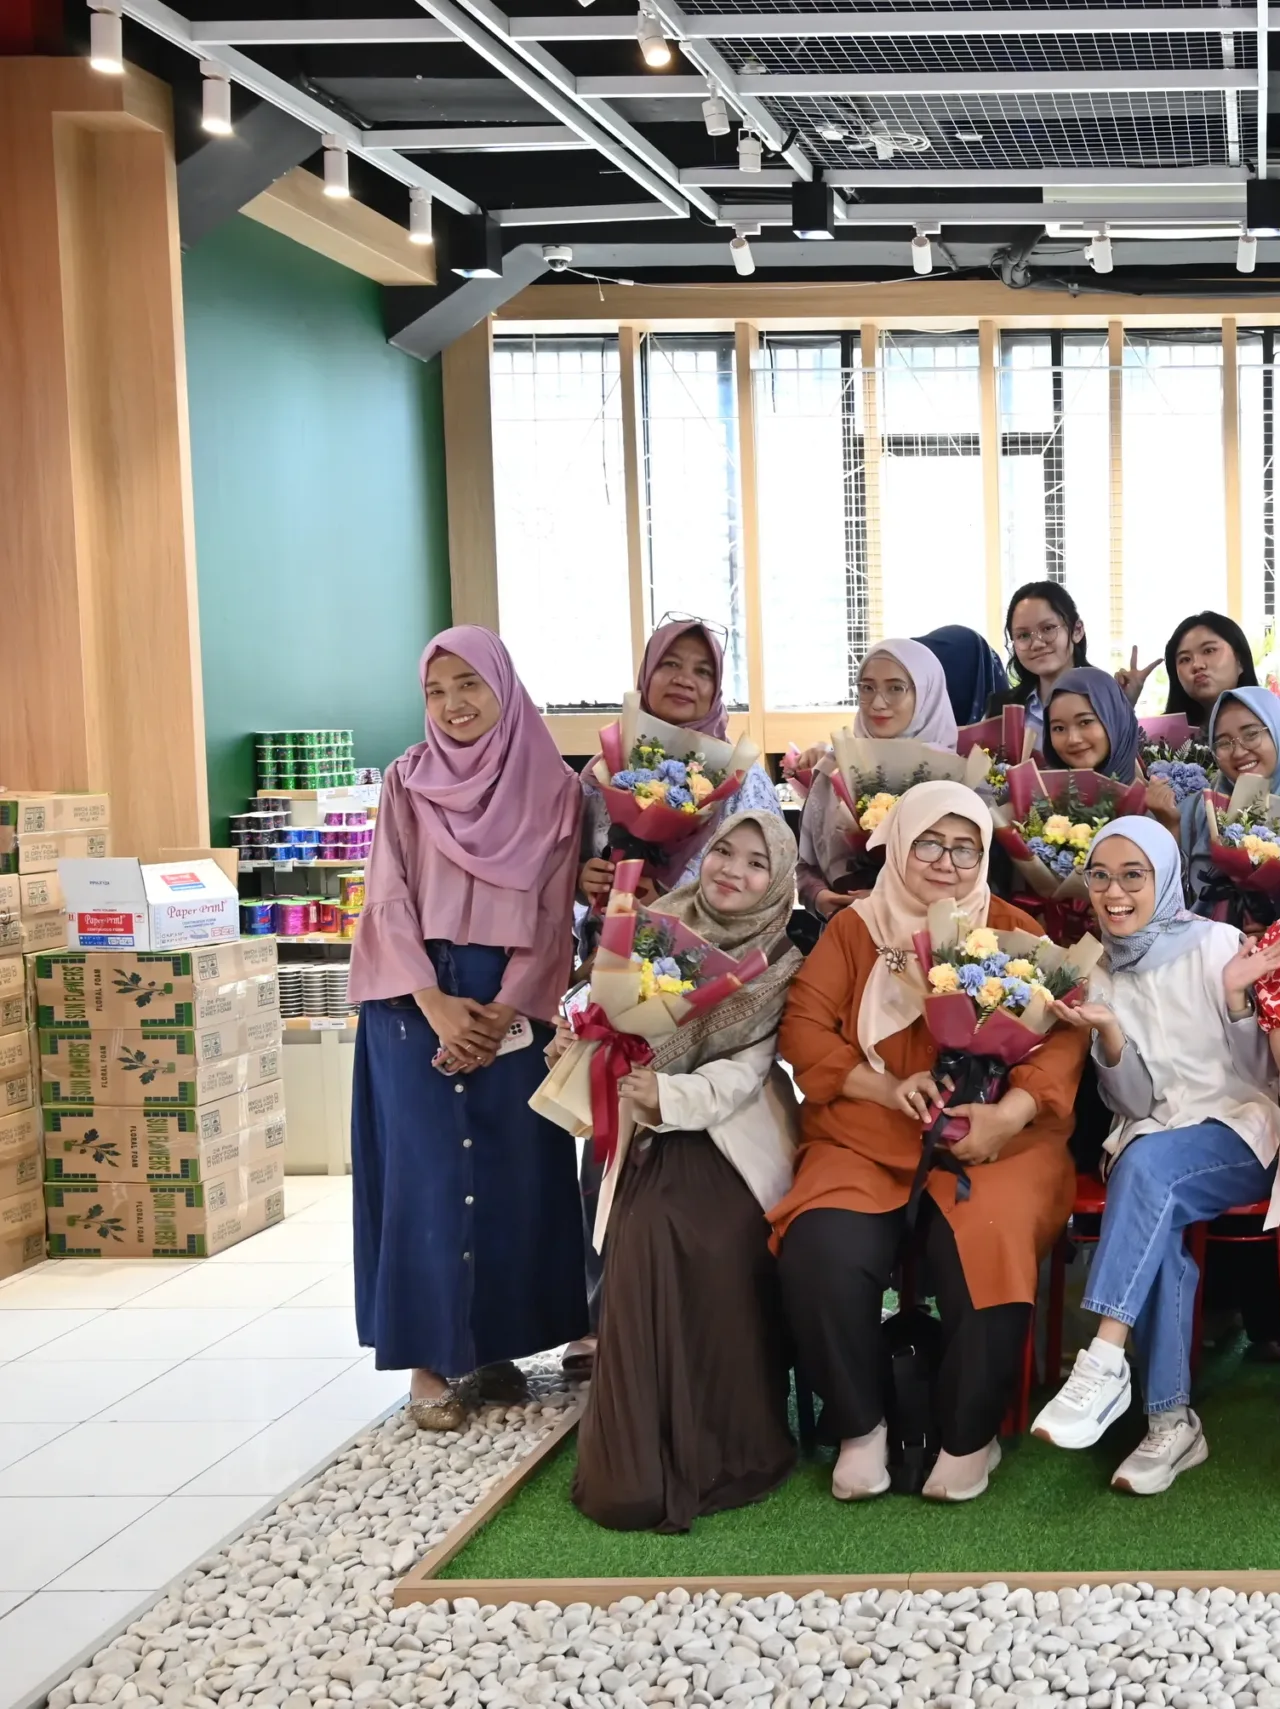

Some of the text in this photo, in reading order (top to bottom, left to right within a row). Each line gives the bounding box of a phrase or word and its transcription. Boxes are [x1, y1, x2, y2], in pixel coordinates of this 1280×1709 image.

[166, 900, 224, 919] Paper Print
[84, 914, 123, 926] Paper Print
[94, 968, 102, 986] FOAM
[64, 1002, 86, 1019] SUN
[70, 1081, 92, 1096] SUN
[146, 1118, 168, 1134] SUN
[130, 1126, 138, 1149] FLORAL
[153, 1194, 176, 1209] SUN
